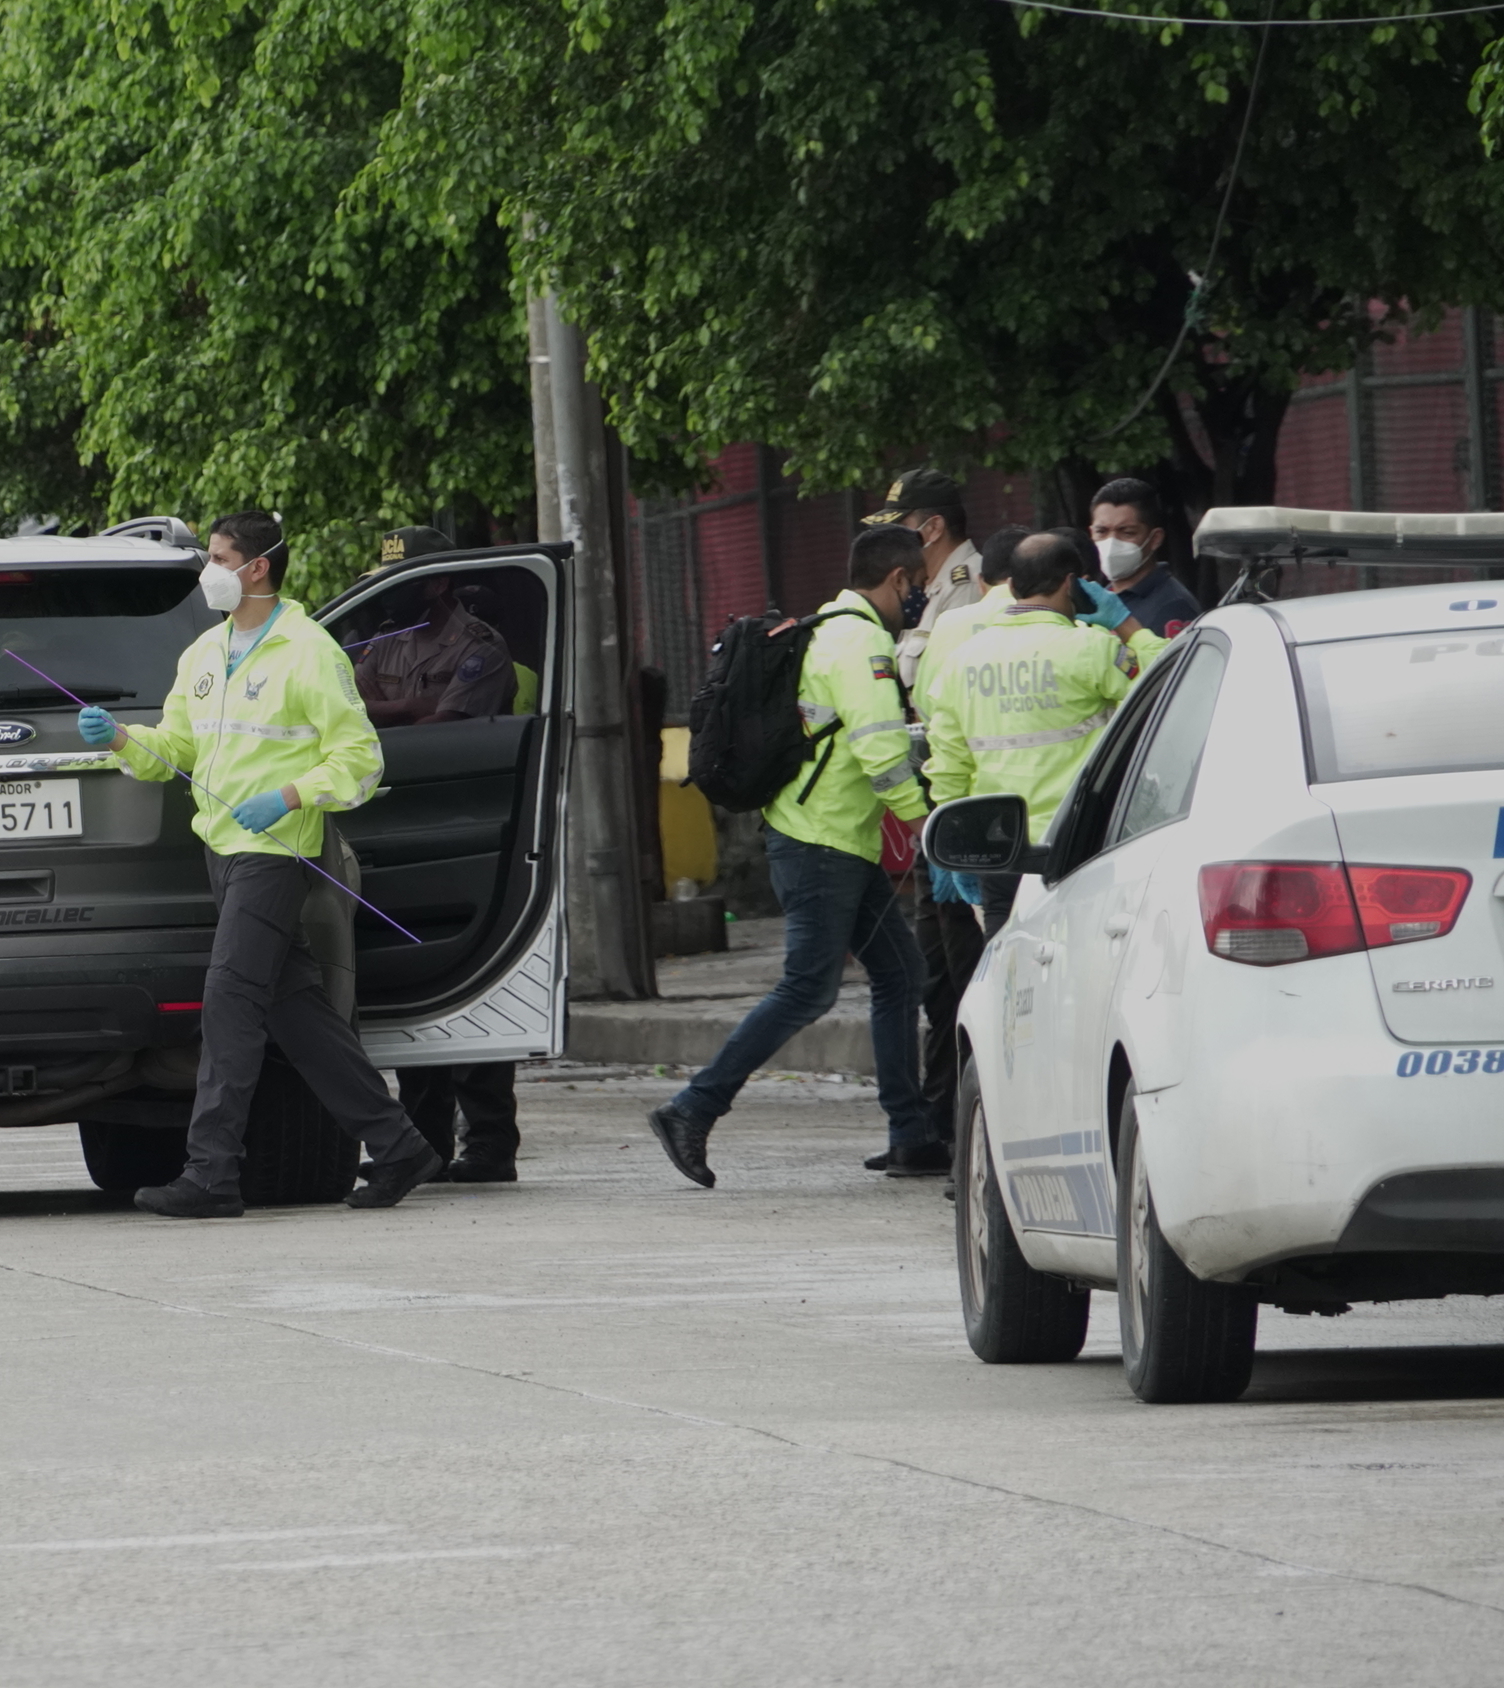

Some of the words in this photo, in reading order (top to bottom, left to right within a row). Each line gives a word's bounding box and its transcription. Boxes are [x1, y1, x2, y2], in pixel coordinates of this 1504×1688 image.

[966, 651, 1059, 699] POLICÍA
[1392, 976, 1494, 993] CERATO
[1396, 1049, 1504, 1077] 0038
